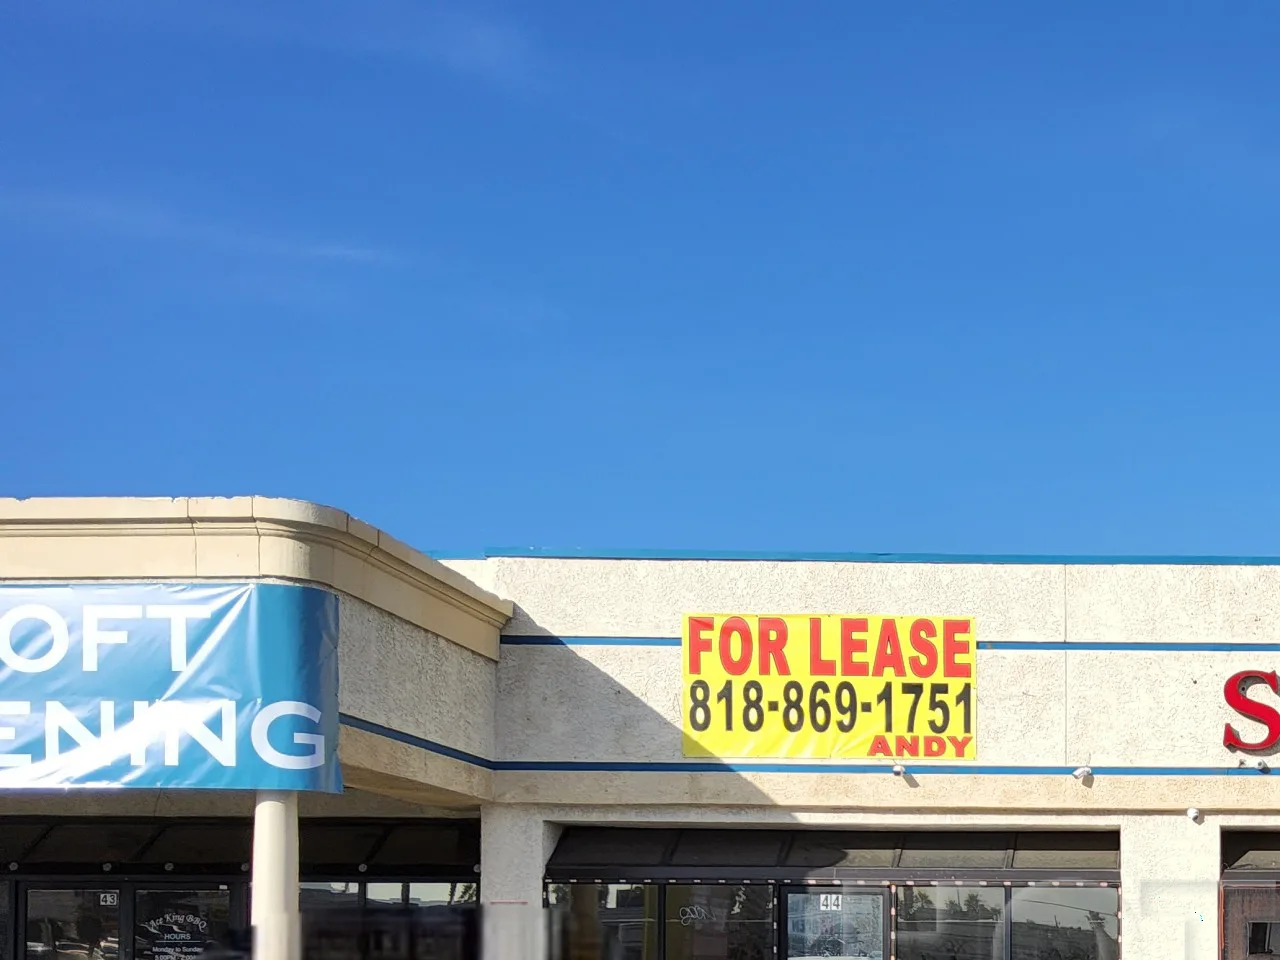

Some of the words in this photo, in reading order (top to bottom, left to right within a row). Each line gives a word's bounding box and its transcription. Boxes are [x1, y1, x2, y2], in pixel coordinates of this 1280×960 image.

[688, 616, 791, 676] FOR
[809, 617, 972, 678] LEASE
[689, 679, 972, 735] 818-869-1751
[867, 735, 973, 758] ANDY
[100, 894, 117, 905] 43
[820, 894, 842, 910] 44
